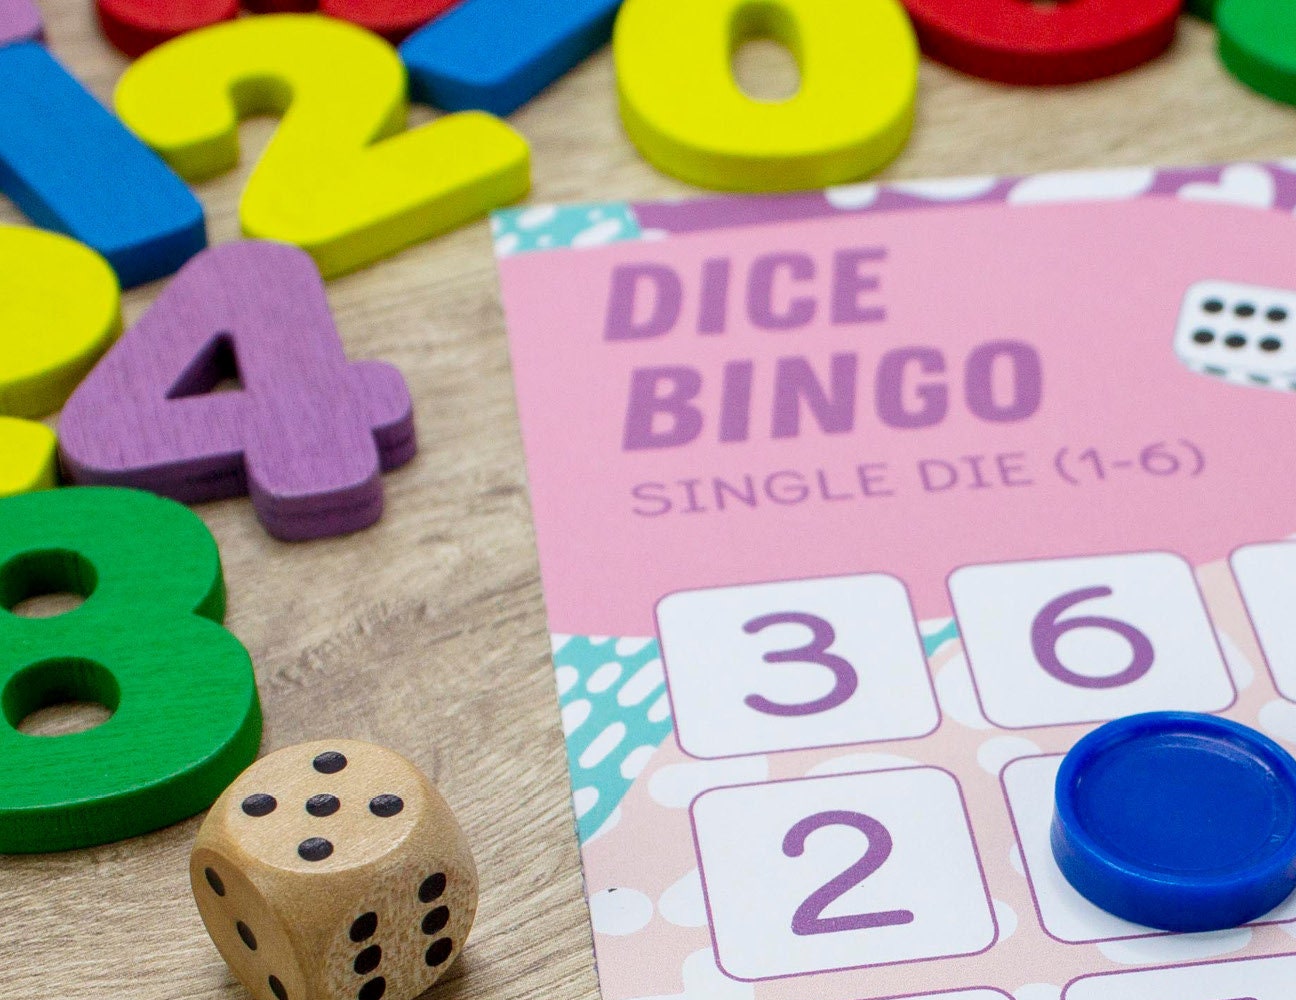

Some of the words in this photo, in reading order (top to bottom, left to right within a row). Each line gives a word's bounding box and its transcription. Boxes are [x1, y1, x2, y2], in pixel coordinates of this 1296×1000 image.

[603, 246, 889, 342] DICE
[58, 240, 417, 541] 4
[621, 339, 1043, 452] BINGO
[630, 462, 894, 517] SINGLE
[918, 452, 1034, 493] DIE
[1053, 438, 1206, 487] (1-6)
[744, 613, 858, 715] 3
[1031, 587, 1154, 688] 6
[782, 811, 914, 935] 2
